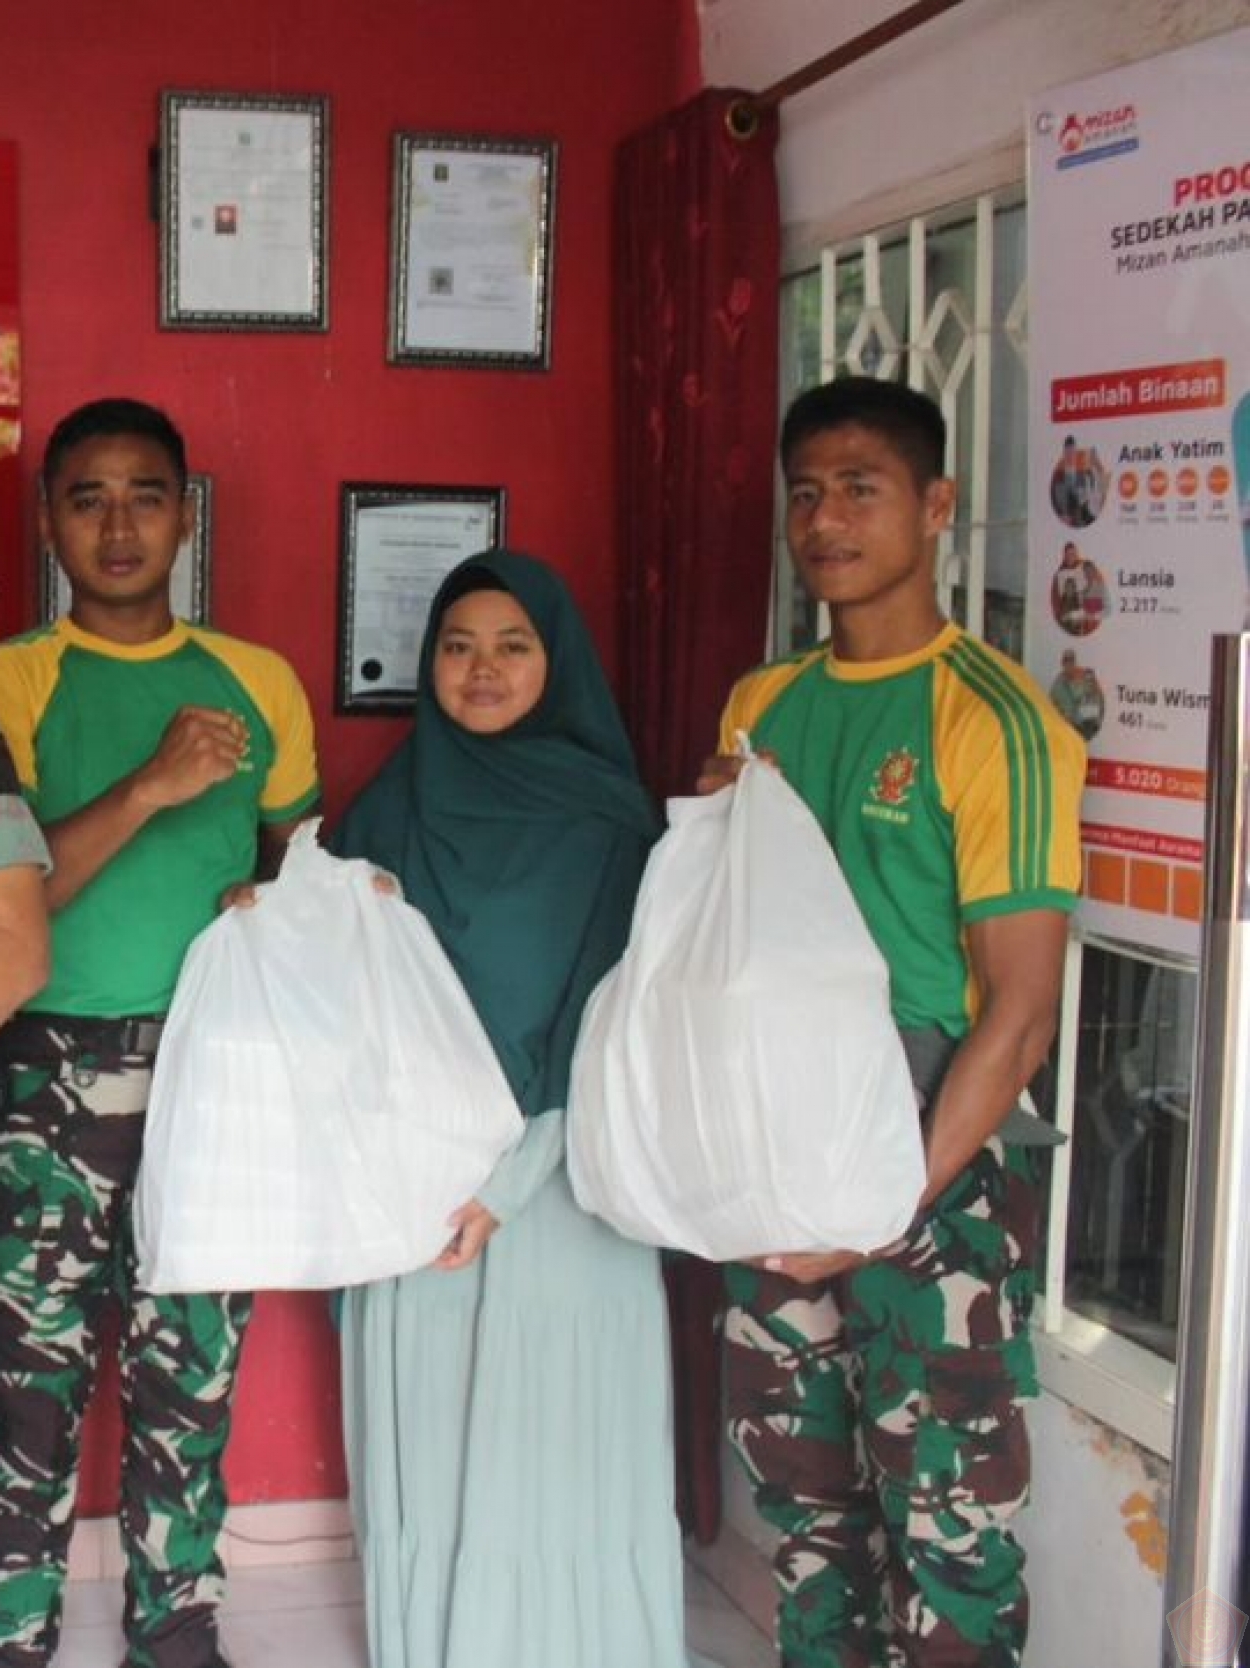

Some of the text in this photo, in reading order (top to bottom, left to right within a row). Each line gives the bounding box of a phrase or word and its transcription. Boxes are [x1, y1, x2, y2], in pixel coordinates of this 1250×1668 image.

[1111, 205, 1214, 250] SEDEKAH
[1116, 250, 1168, 275] Mizan
[1056, 374, 1219, 413] Jumlah Binaan
[1118, 437, 1225, 463] Anak Yatim
[1117, 568, 1175, 588] Lansia
[1119, 596, 1159, 614] 2.217
[1117, 686, 1158, 706] Tuna
[1117, 710, 1144, 728] 461
[1115, 765, 1163, 790] 5.020
